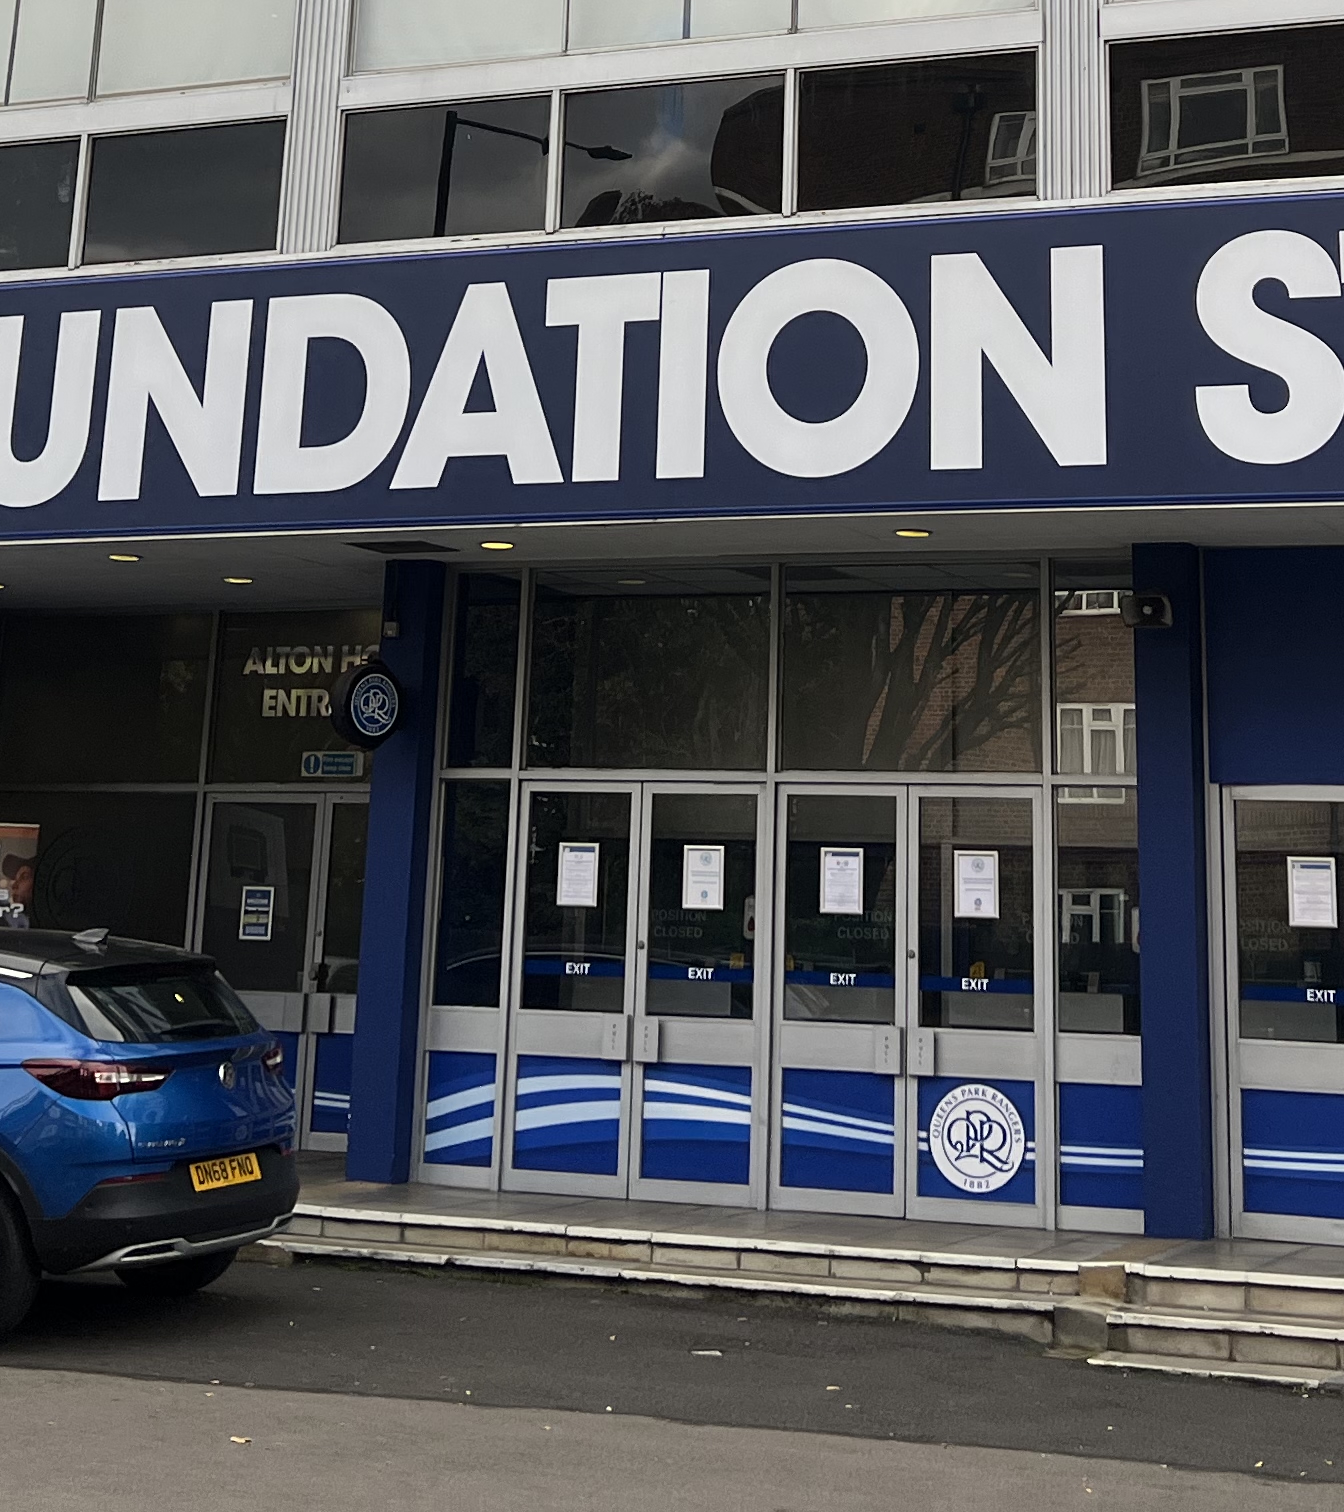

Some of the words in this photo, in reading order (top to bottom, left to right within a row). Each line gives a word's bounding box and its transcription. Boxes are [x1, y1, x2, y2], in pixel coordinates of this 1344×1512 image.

[242, 646, 334, 675] ALTON
[262, 689, 332, 717] ENTR
[837, 926, 889, 940] CLOSED
[565, 962, 591, 975] EXIT
[688, 967, 714, 980] EXIT
[829, 972, 857, 986] EXIT
[961, 978, 989, 991] EXIT
[1306, 988, 1336, 1003] EXIT
[932, 1092, 958, 1139] QUEENS
[961, 1087, 988, 1099] PARK
[991, 1092, 1022, 1144] RANGERS
[195, 1162, 229, 1186] DN68
[963, 1179, 991, 1189] 1882
